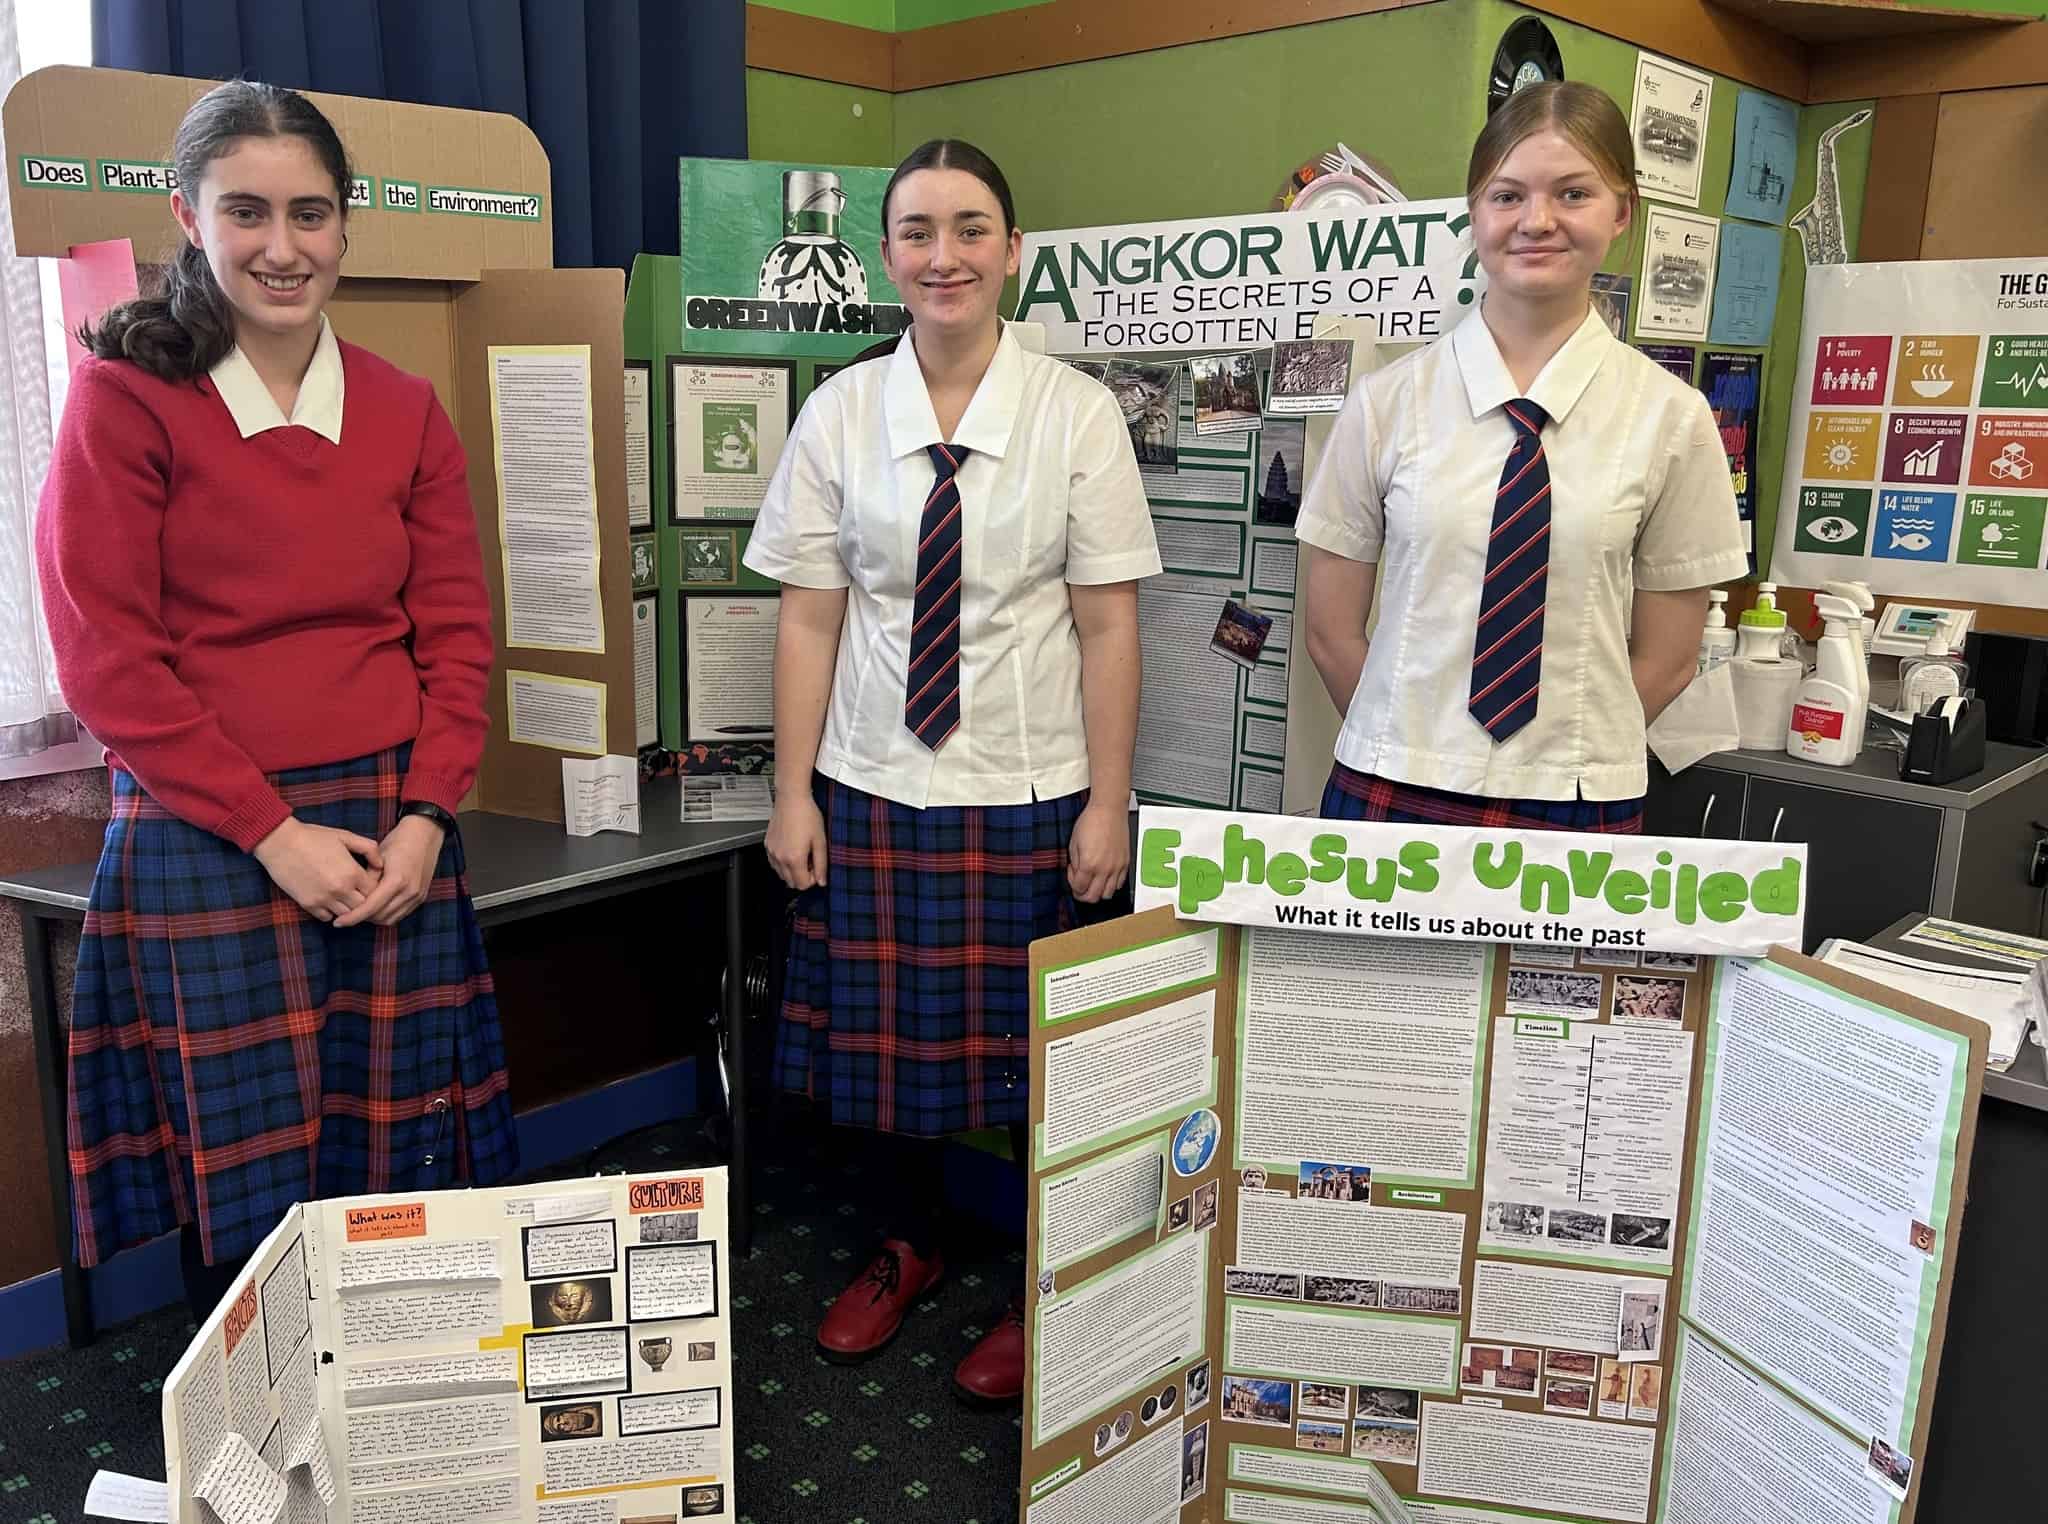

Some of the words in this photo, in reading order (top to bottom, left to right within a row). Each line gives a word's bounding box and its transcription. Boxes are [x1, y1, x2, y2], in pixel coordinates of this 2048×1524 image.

[26, 159, 85, 184] Does
[103, 164, 179, 190] Plant-B
[386, 185, 417, 206] the
[428, 190, 538, 216] Environment?
[1014, 225, 1283, 322] ANGKOR
[1999, 273, 2033, 295] THE
[1093, 289, 1159, 317] THE
[1173, 280, 1332, 313] SECRETS
[1348, 276, 1399, 304] OF
[1412, 274, 1436, 301] A
[1997, 297, 2016, 311] For
[2017, 297, 2048, 310] Susta
[687, 297, 915, 335] GREENWASHIN
[1084, 316, 1278, 347] FORGOTTEN
[1295, 309, 1441, 340] EIRE
[1825, 341, 1833, 357] 1
[1905, 340, 1915, 357] 2
[1994, 340, 2005, 357] 3
[2028, 340, 2048, 349] HEALT
[1836, 349, 1862, 358] POVERTY
[1815, 417, 1823, 432] 7
[1894, 418, 1904, 434] 8
[1908, 418, 1930, 427] DECENT
[1931, 419, 1948, 427] WORK
[1981, 420, 1991, 436] 9
[1907, 427, 1936, 435] ECONOMIC
[1937, 427, 1962, 436] GROWTH
[1803, 491, 1818, 507] 13
[1821, 492, 1844, 500] CLIMATE
[1883, 496, 1897, 511] 14
[1914, 496, 1934, 505] BELOW
[1969, 499, 1985, 515] 15
[1140, 823, 1440, 914] Ephesus
[1472, 840, 1801, 925] Unveiled
[1275, 905, 1338, 927] What
[1345, 908, 1362, 928] it
[1370, 911, 1421, 932] tells
[1428, 917, 1456, 934] us
[1461, 917, 1534, 940] about
[1542, 922, 1584, 942] the
[1591, 927, 1646, 947] past
[1524, 1024, 1558, 1032] Timeline
[629, 1181, 702, 1209] CULTURE
[348, 1211, 377, 1225] What
[381, 1212, 402, 1221] was
[406, 1207, 422, 1219] it?
